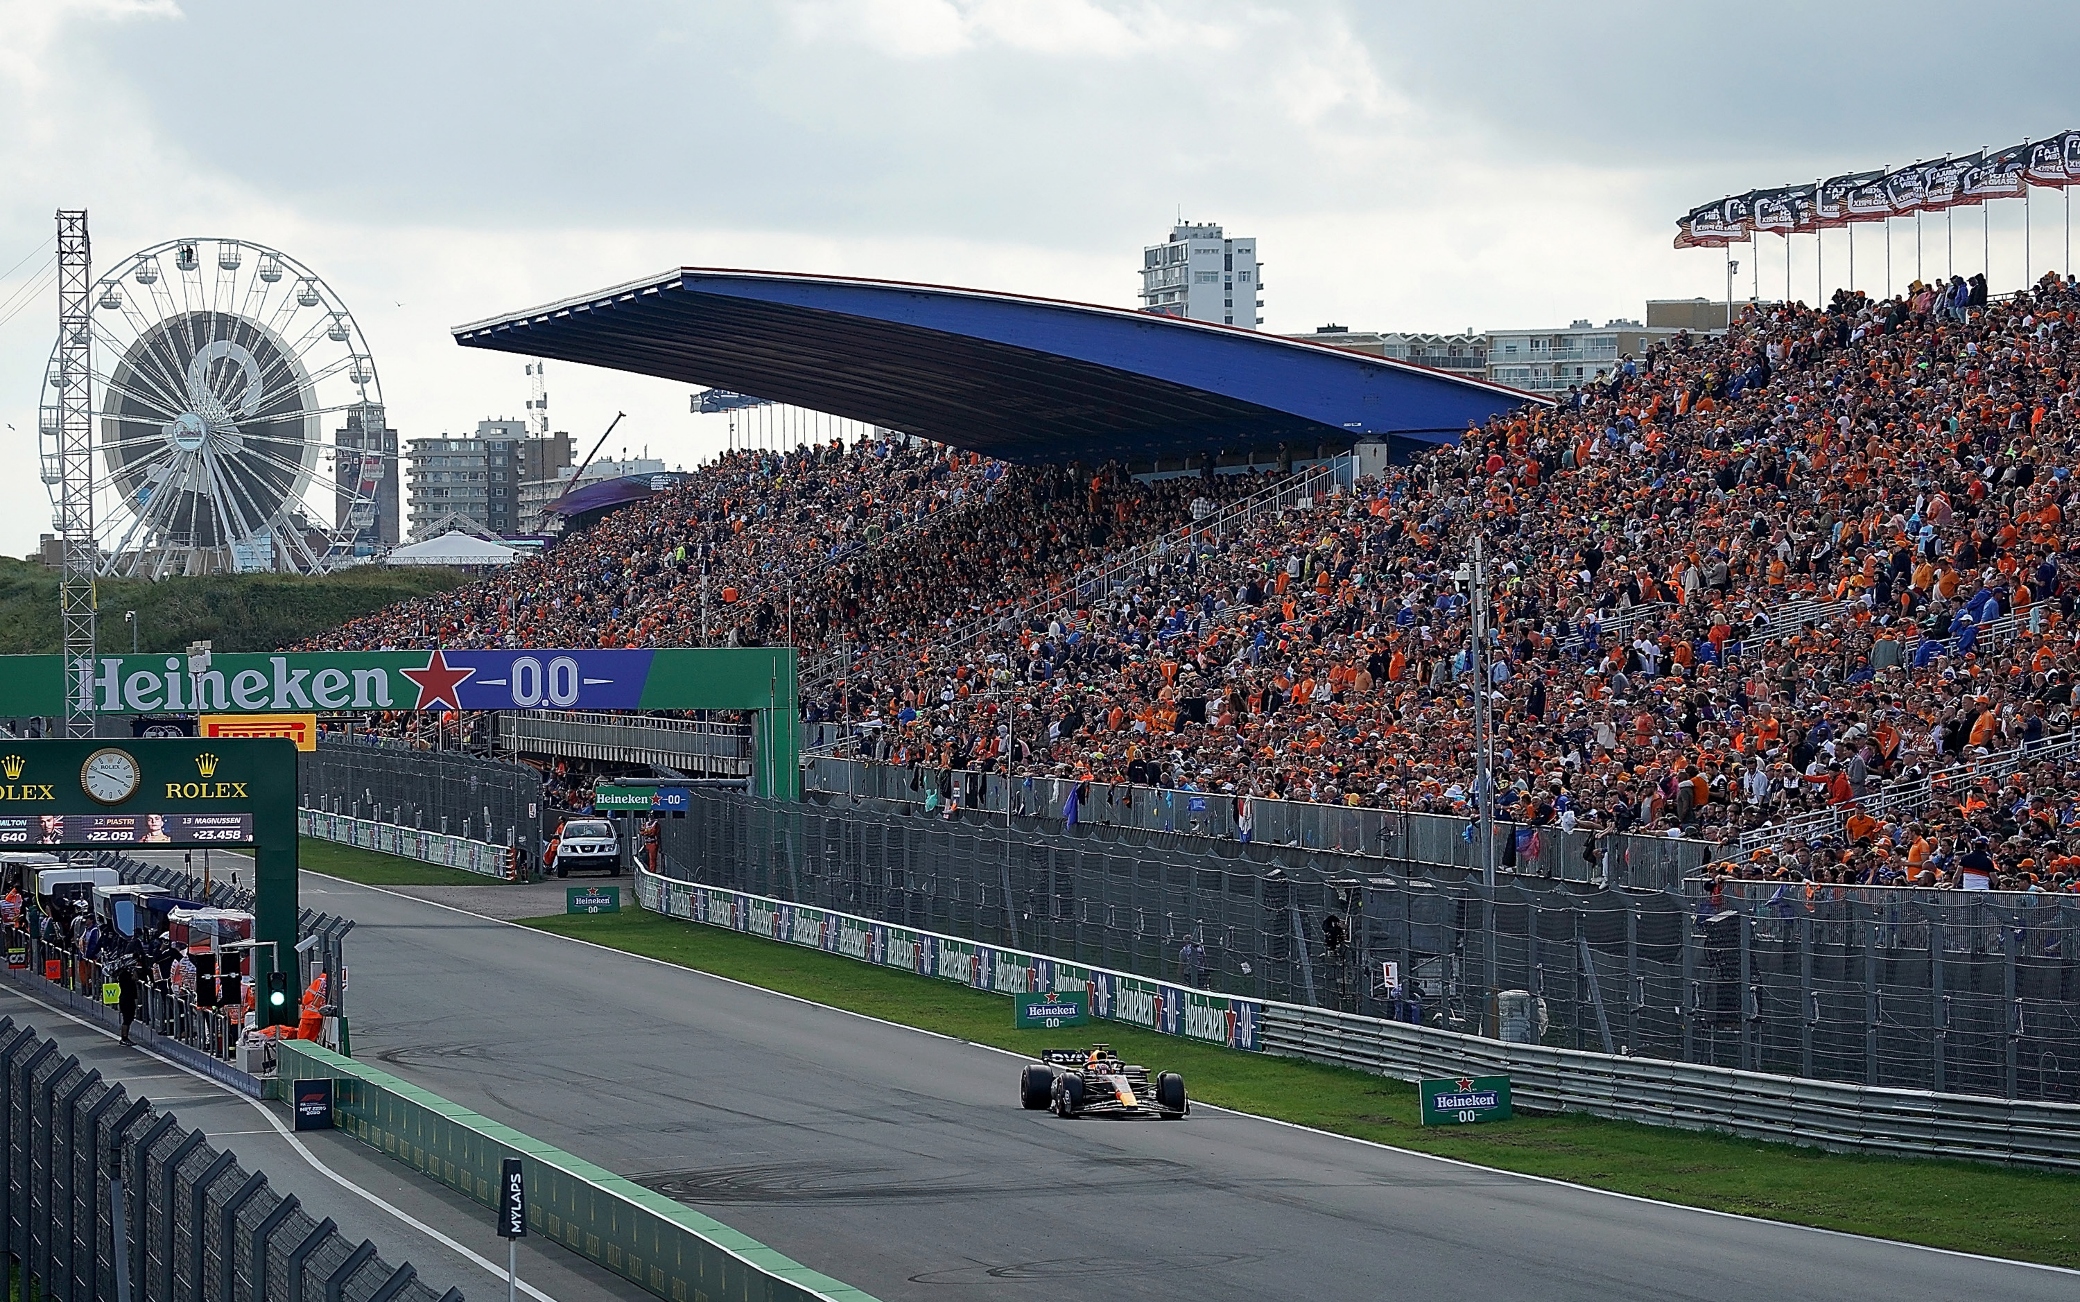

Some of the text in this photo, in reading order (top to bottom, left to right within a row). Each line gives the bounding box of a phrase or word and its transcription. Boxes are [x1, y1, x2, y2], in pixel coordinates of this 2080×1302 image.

[76, 656, 579, 711] Heineken 0.0
[166, 782, 248, 798] ROLEX
[596, 794, 648, 804] Heineken
[87, 832, 134, 841] +22.091
[192, 831, 241, 840] +23.458
[576, 897, 610, 905] Heineken
[938, 939, 970, 982] Heineken
[995, 952, 1026, 993] Heineken
[1115, 977, 1154, 1027] Heineken
[1029, 1005, 1076, 1016] Heineken
[1184, 992, 1225, 1042] Heineken
[1437, 1093, 1495, 1108] Heineken
[510, 1172, 522, 1232] MYLAPS
